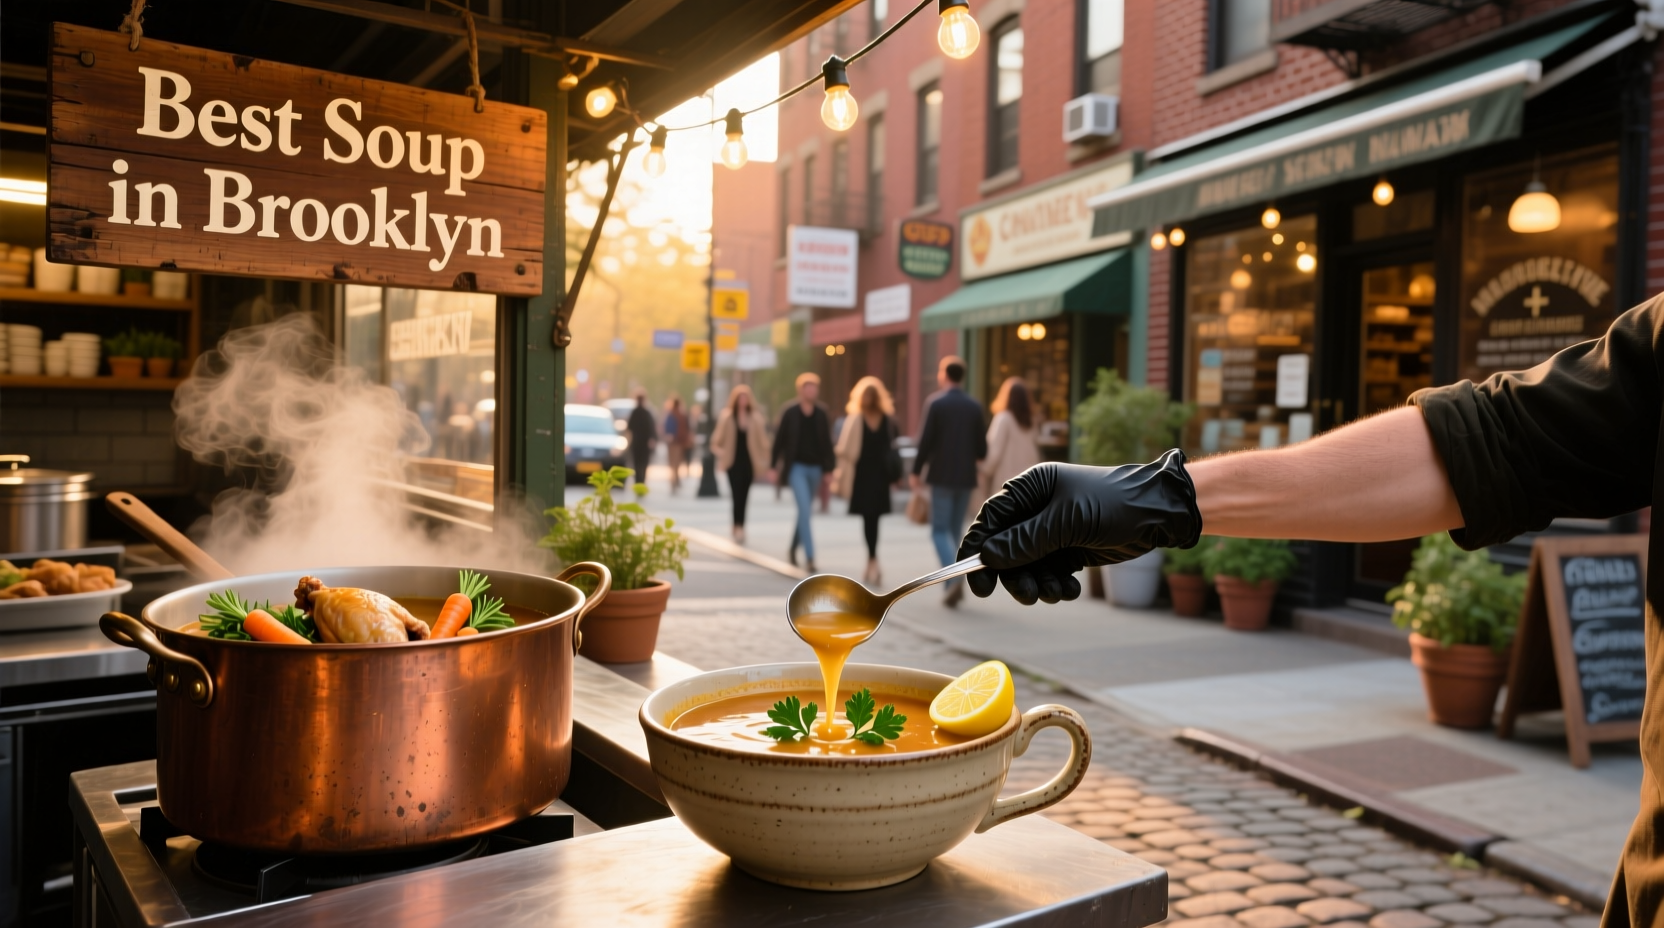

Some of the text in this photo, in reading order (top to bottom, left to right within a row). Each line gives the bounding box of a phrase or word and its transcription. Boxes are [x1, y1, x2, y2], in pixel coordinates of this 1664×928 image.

[136, 66, 485, 197] Best Soup
[107, 159, 505, 272] in Brooklyn
